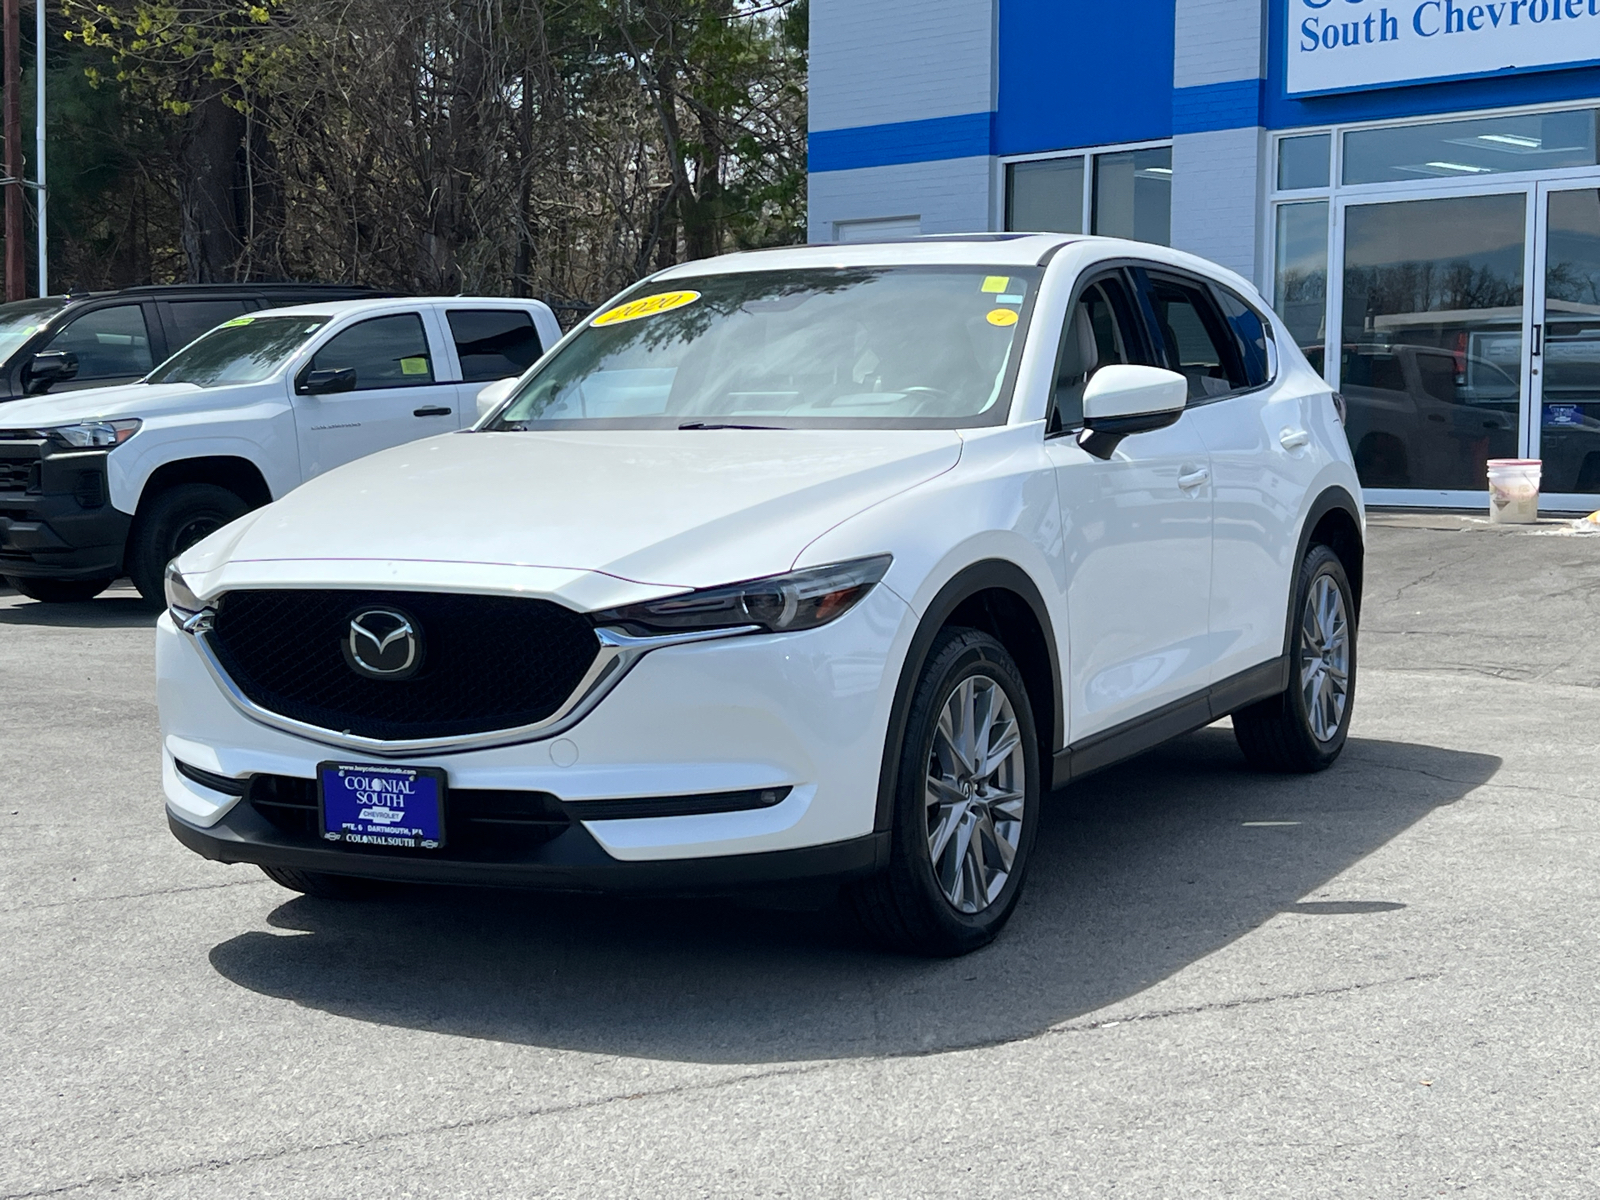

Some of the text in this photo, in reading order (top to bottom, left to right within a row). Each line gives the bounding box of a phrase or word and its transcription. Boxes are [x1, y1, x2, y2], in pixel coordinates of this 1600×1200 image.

[1300, 8, 1399, 53] South
[603, 294, 684, 322] 2020
[344, 776, 415, 795] COLONIAL
[356, 791, 404, 808] SOUTH
[363, 810, 400, 820] CHEVROLET
